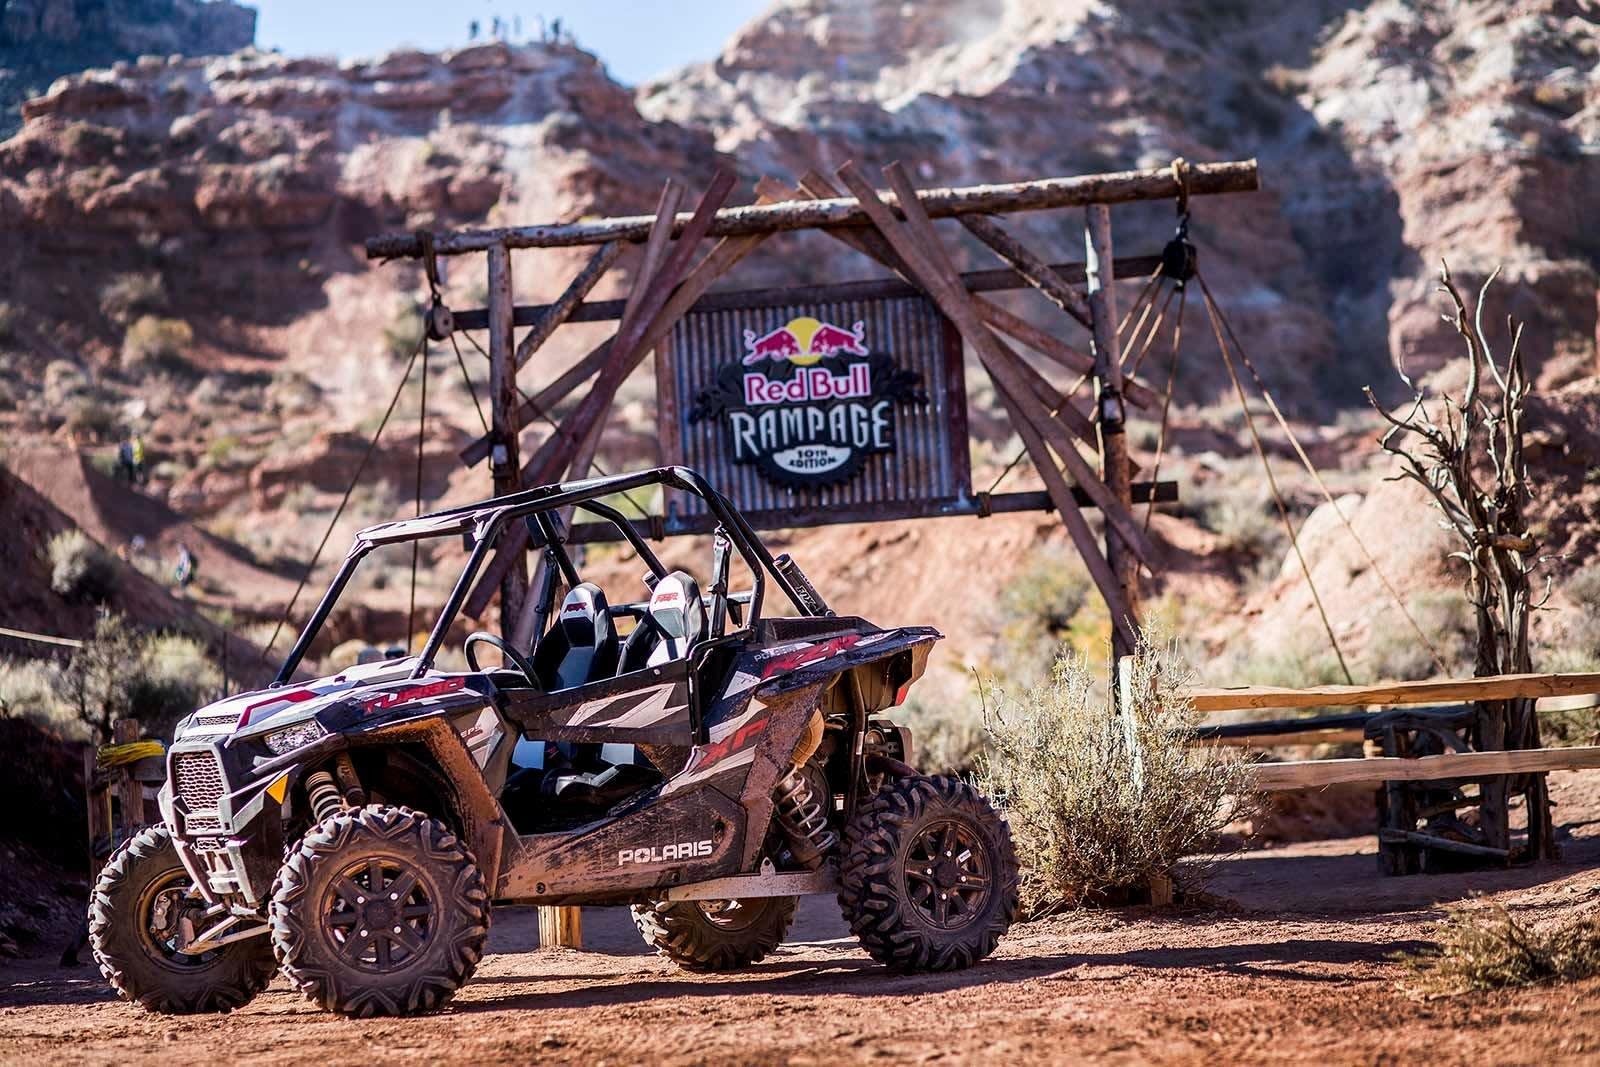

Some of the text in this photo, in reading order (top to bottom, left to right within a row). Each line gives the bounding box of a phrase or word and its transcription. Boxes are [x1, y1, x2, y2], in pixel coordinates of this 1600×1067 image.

[744, 362, 871, 405] Red Bull
[730, 401, 890, 459] RAMPAGE
[788, 457, 837, 469] EDITION
[797, 449, 828, 459] 10TH
[618, 839, 713, 866] POLARIS
